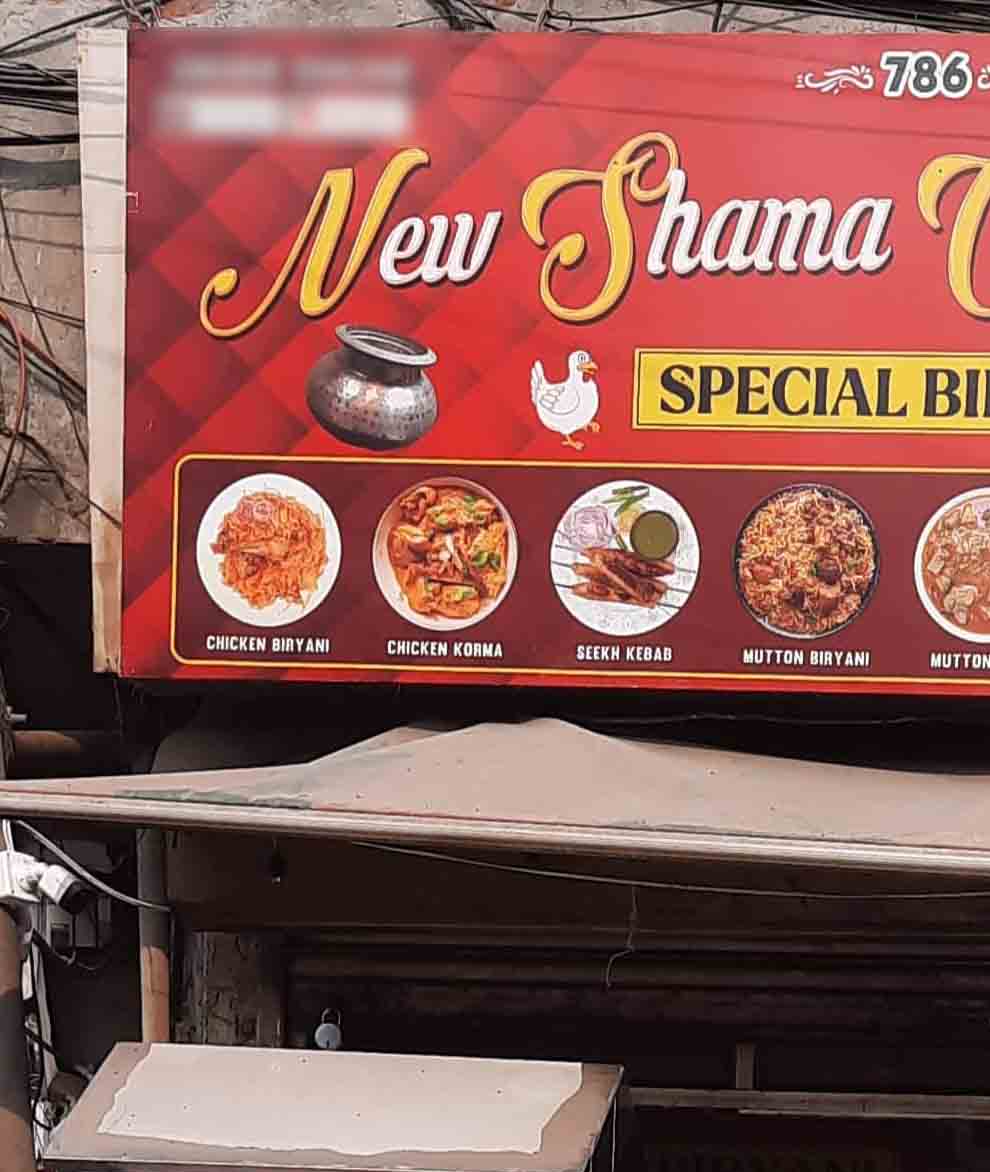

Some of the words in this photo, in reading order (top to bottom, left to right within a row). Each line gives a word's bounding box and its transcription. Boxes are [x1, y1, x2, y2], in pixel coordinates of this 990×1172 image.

[879, 50, 973, 99] 786
[199, 148, 502, 337] New
[521, 131, 893, 322] Shama
[661, 365, 907, 417] SPECIAL
[206, 635, 266, 651] CHICKEN
[271, 637, 330, 653] BIRYANI
[387, 640, 448, 656] CHICKEN
[453, 642, 503, 657] KORMA
[576, 645, 620, 661] SEEKH
[626, 646, 672, 661] KEBAB
[743, 649, 804, 665] MUTTON
[810, 650, 870, 666] BIRYANI
